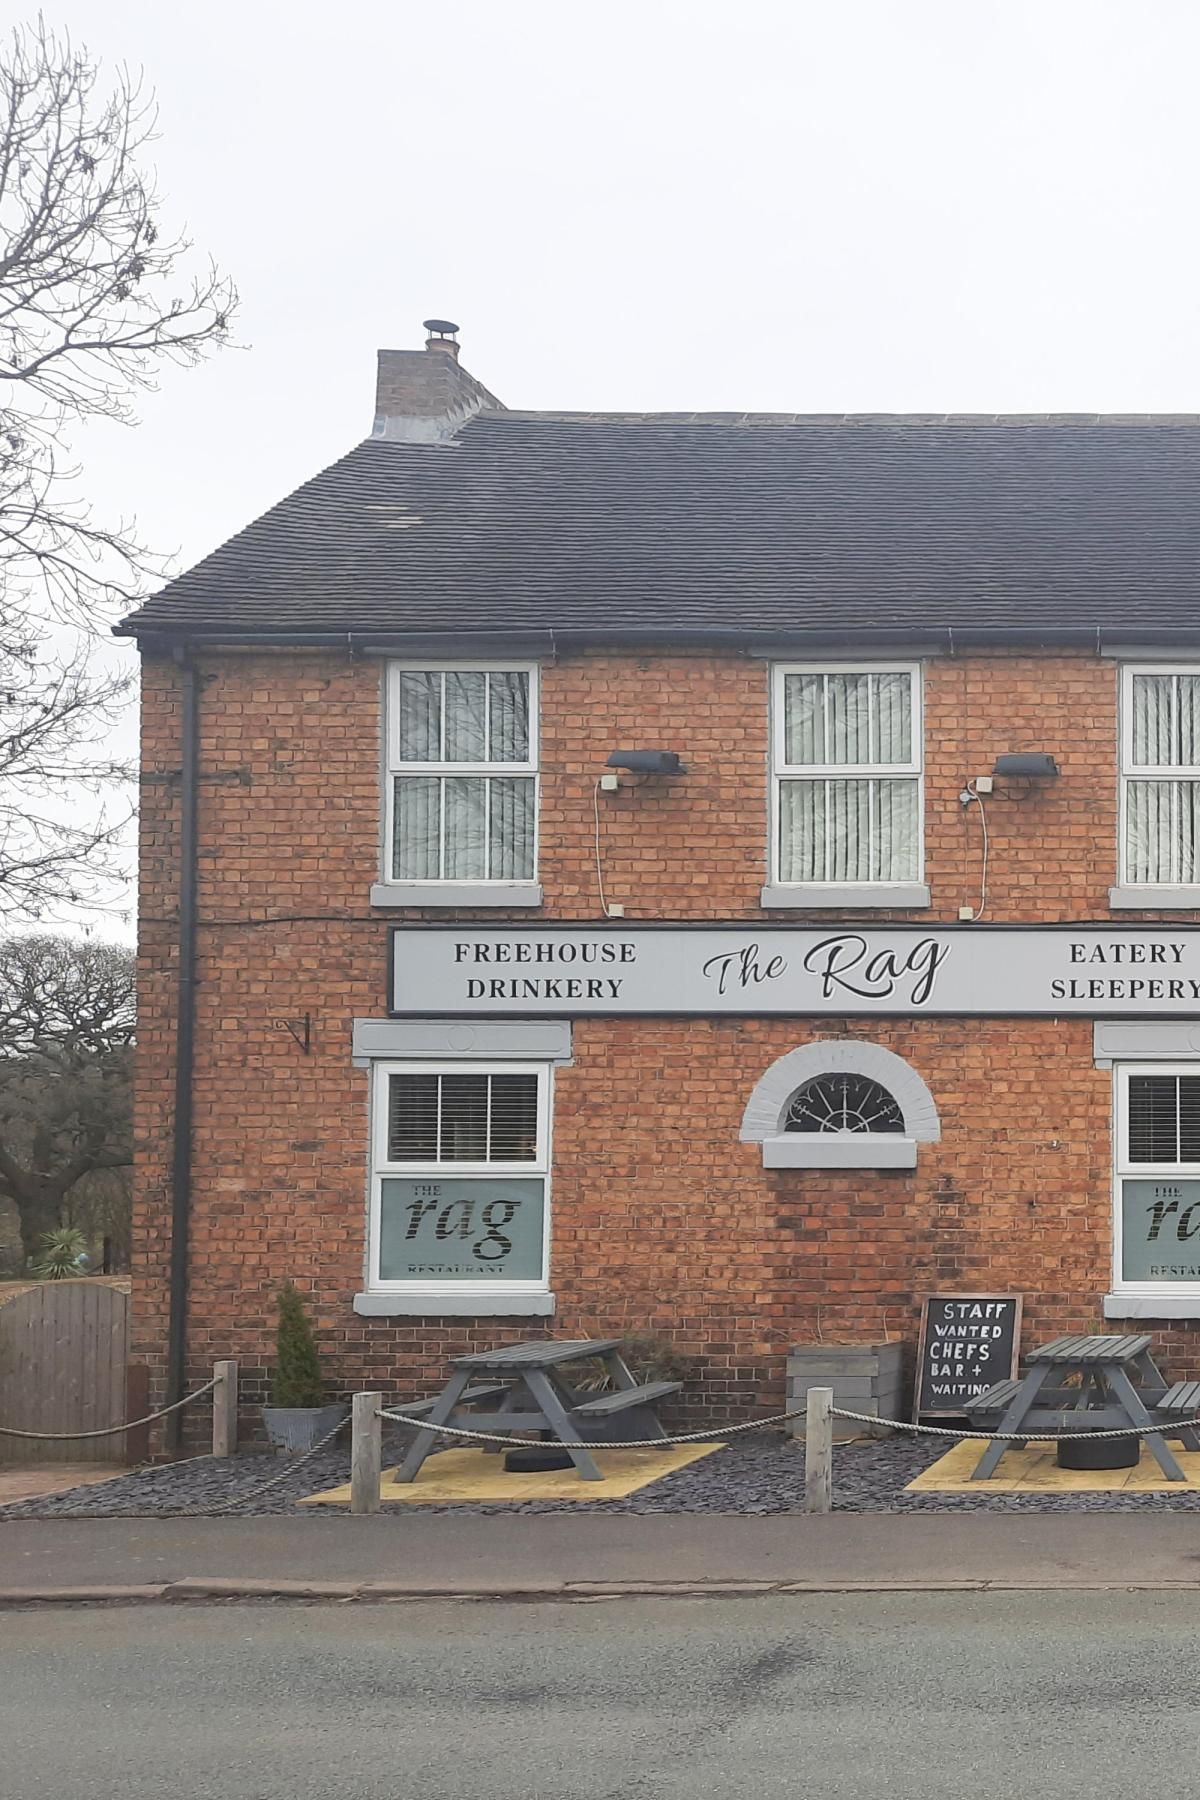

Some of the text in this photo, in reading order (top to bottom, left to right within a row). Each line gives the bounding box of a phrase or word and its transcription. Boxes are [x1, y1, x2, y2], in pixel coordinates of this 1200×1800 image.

[453, 943, 637, 963] FREEHOUSE
[1068, 943, 1187, 963] EATERY
[702, 934, 950, 1005] The Rag
[466, 978, 624, 999] DRINKERY
[412, 1185, 442, 1196] THE
[405, 1199, 522, 1261] rag
[943, 1303, 1007, 1320] STAFF
[934, 1324, 1002, 1339] WANTED
[929, 1341, 990, 1361] CHEFS
[930, 1363, 964, 1377] BAR
